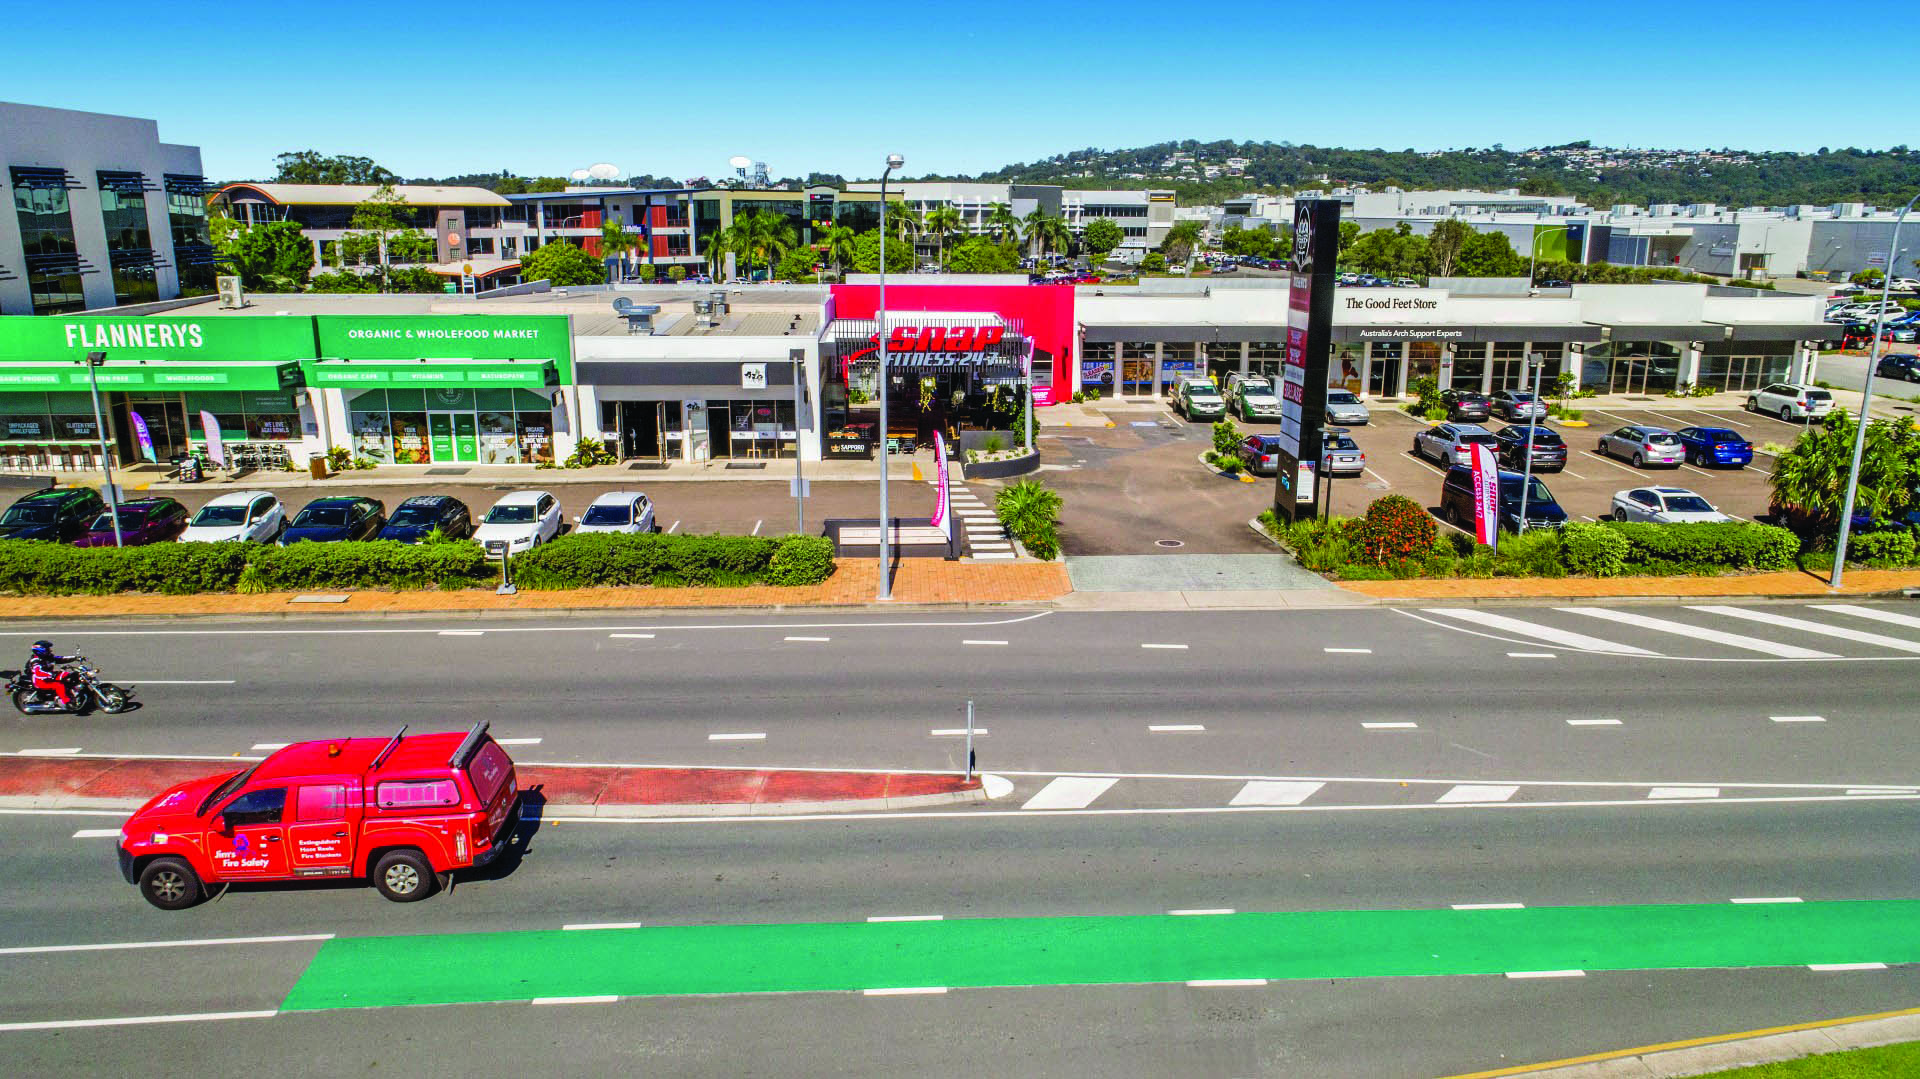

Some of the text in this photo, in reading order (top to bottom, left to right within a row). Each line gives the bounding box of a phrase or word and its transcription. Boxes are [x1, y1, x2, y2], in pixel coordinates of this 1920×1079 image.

[1345, 298, 1437, 309] The Good Feet Store
[64, 324, 203, 348] FLANNERYS
[348, 329, 539, 339] ORGANIC & WHOLEFOOD MARKET
[1360, 329, 1462, 339] Australia's Arch Support Experts
[1473, 470, 1483, 500] ACCESS
[299, 839, 341, 847] Extinguishers
[214, 850, 237, 859] Jim's
[223, 858, 270, 868] Fire Safety
